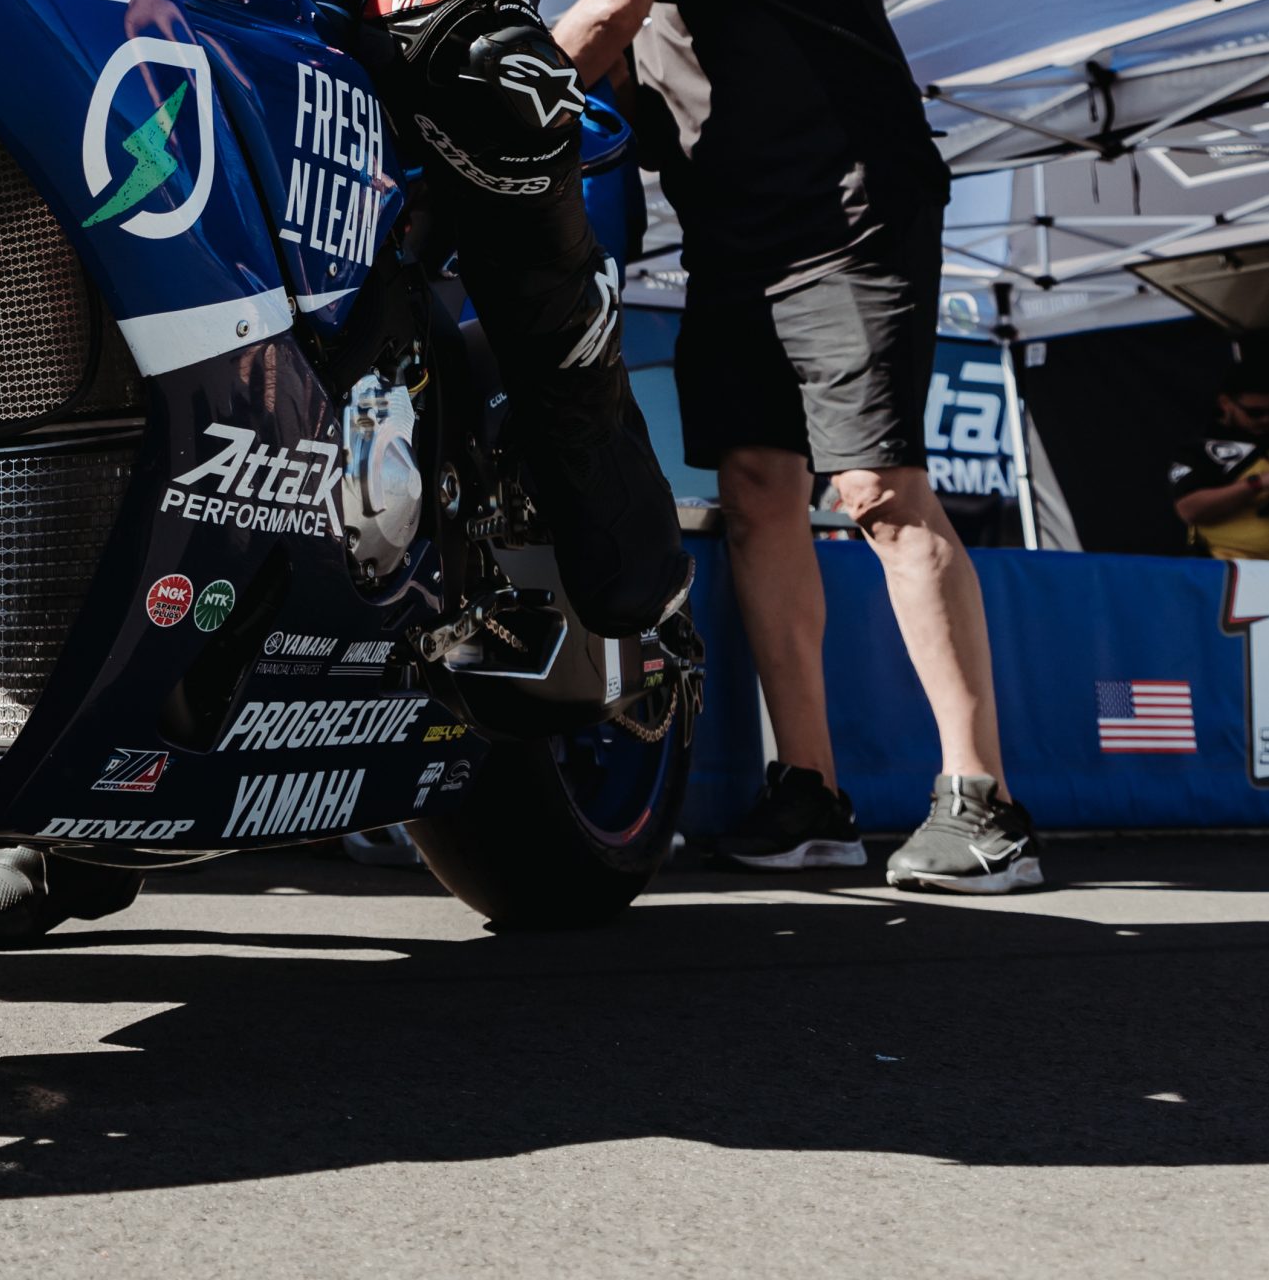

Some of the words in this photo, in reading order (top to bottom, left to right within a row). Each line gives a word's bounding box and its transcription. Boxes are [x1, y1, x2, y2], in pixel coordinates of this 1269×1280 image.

[297, 61, 384, 181] FRESH
[500, 155, 529, 163] one
[279, 159, 311, 245] N
[309, 173, 383, 268] LEAN
[173, 422, 345, 538] Attack
[160, 488, 328, 538] PERFORMANCE
[157, 585, 188, 601] NGK
[203, 592, 229, 607] NTK
[153, 609, 180, 619] PLUGS
[155, 601, 181, 612] SPARK
[281, 634, 338, 657] YAMAHA
[340, 641, 396, 664] YAMALUBE
[255, 662, 291, 675] FINANCIAL
[217, 697, 429, 752] PROGRESSIVE
[221, 768, 366, 838] YAMAHA
[36, 818, 195, 840] DUNLOP
